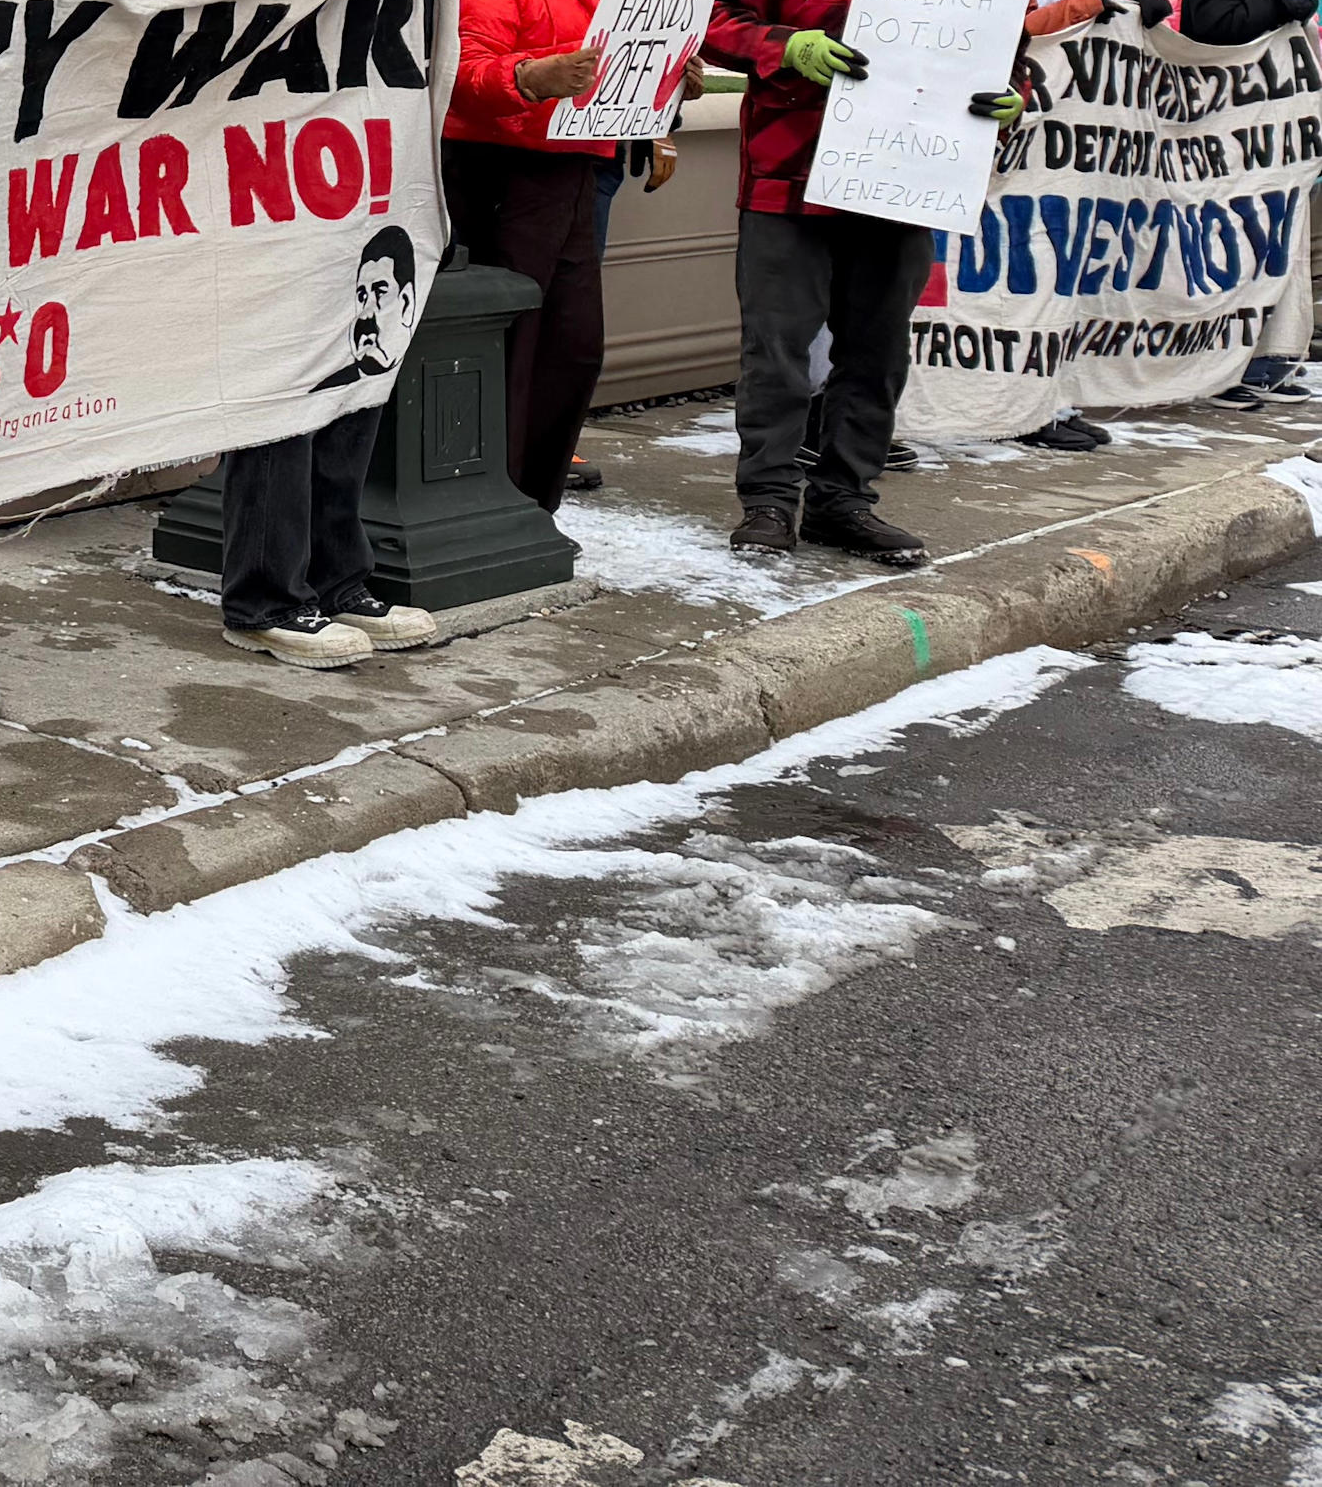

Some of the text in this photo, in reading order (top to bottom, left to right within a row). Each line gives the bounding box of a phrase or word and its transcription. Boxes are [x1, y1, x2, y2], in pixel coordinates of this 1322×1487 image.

[556, 105, 674, 137] VENEZUELA!
[1231, 115, 1322, 171] WAR
[820, 149, 874, 167] OFF
[865, 127, 960, 162] HANDS
[7, 133, 200, 267] WAR
[223, 117, 393, 227] NO!
[821, 175, 967, 216] VENEZUELA
[1172, 186, 1300, 298] NOW
[910, 321, 1020, 373] TROIT
